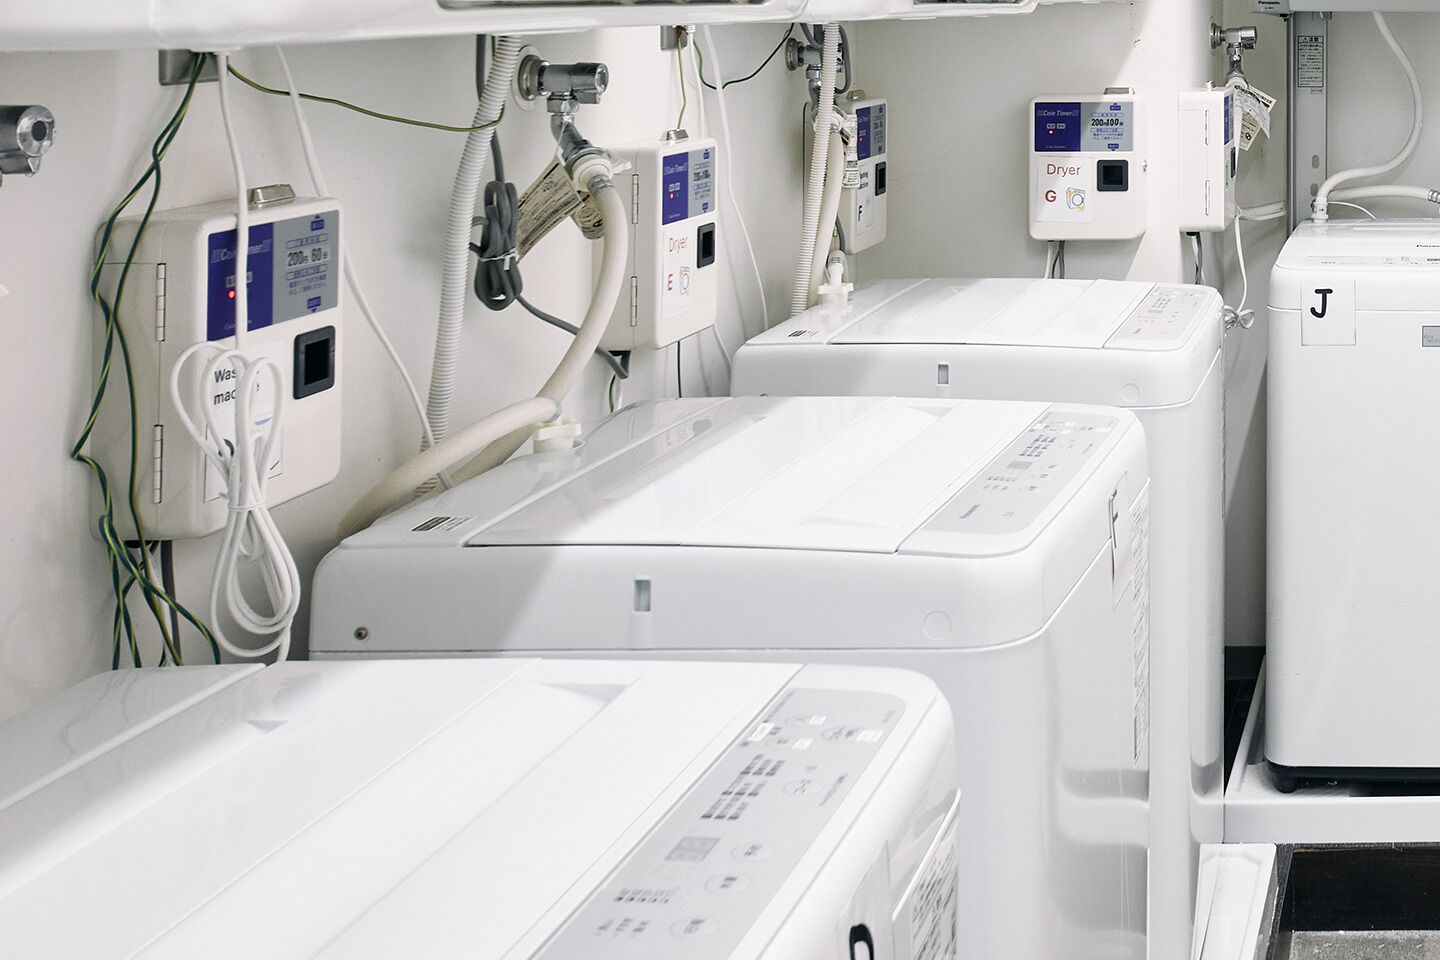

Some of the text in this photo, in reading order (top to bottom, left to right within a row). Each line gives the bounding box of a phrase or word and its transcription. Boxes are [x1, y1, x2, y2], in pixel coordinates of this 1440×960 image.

[1046, 163, 1081, 178] Dryer
[1045, 189, 1057, 203] G
[668, 237, 688, 254] Dryer
[667, 273, 673, 291] E
[1310, 288, 1333, 319] J
